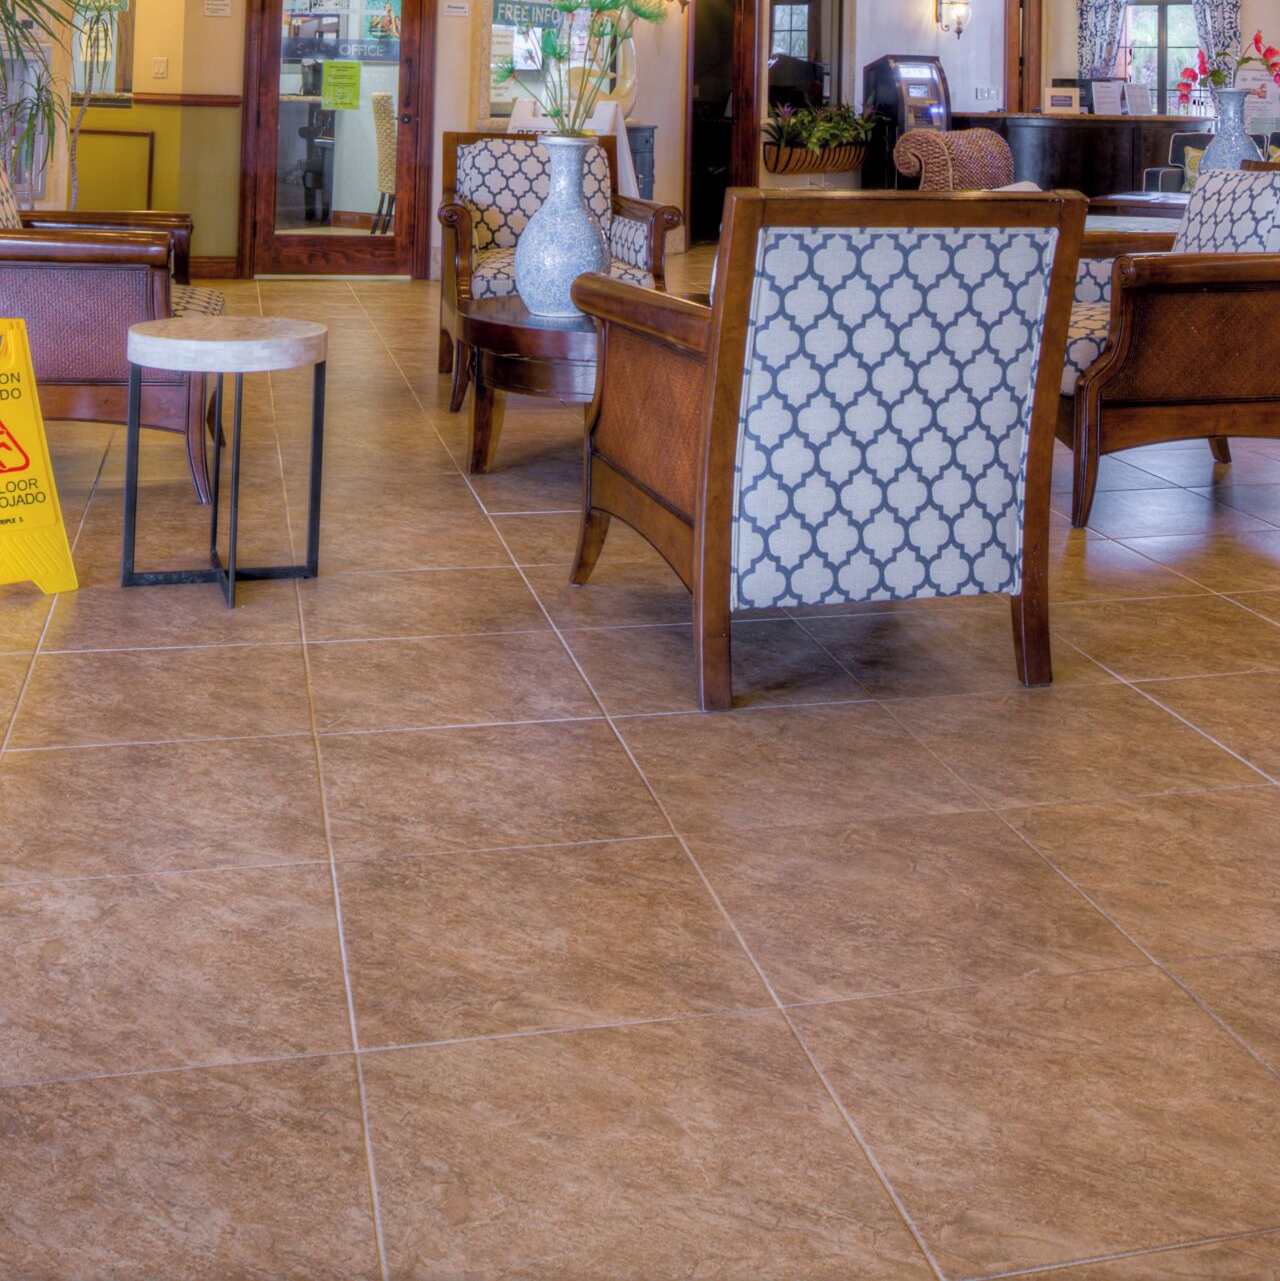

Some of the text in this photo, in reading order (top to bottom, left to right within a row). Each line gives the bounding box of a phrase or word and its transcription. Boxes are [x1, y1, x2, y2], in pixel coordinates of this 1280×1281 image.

[497, 3, 561, 24] FREE INFO
[339, 44, 385, 56] OFFICE
